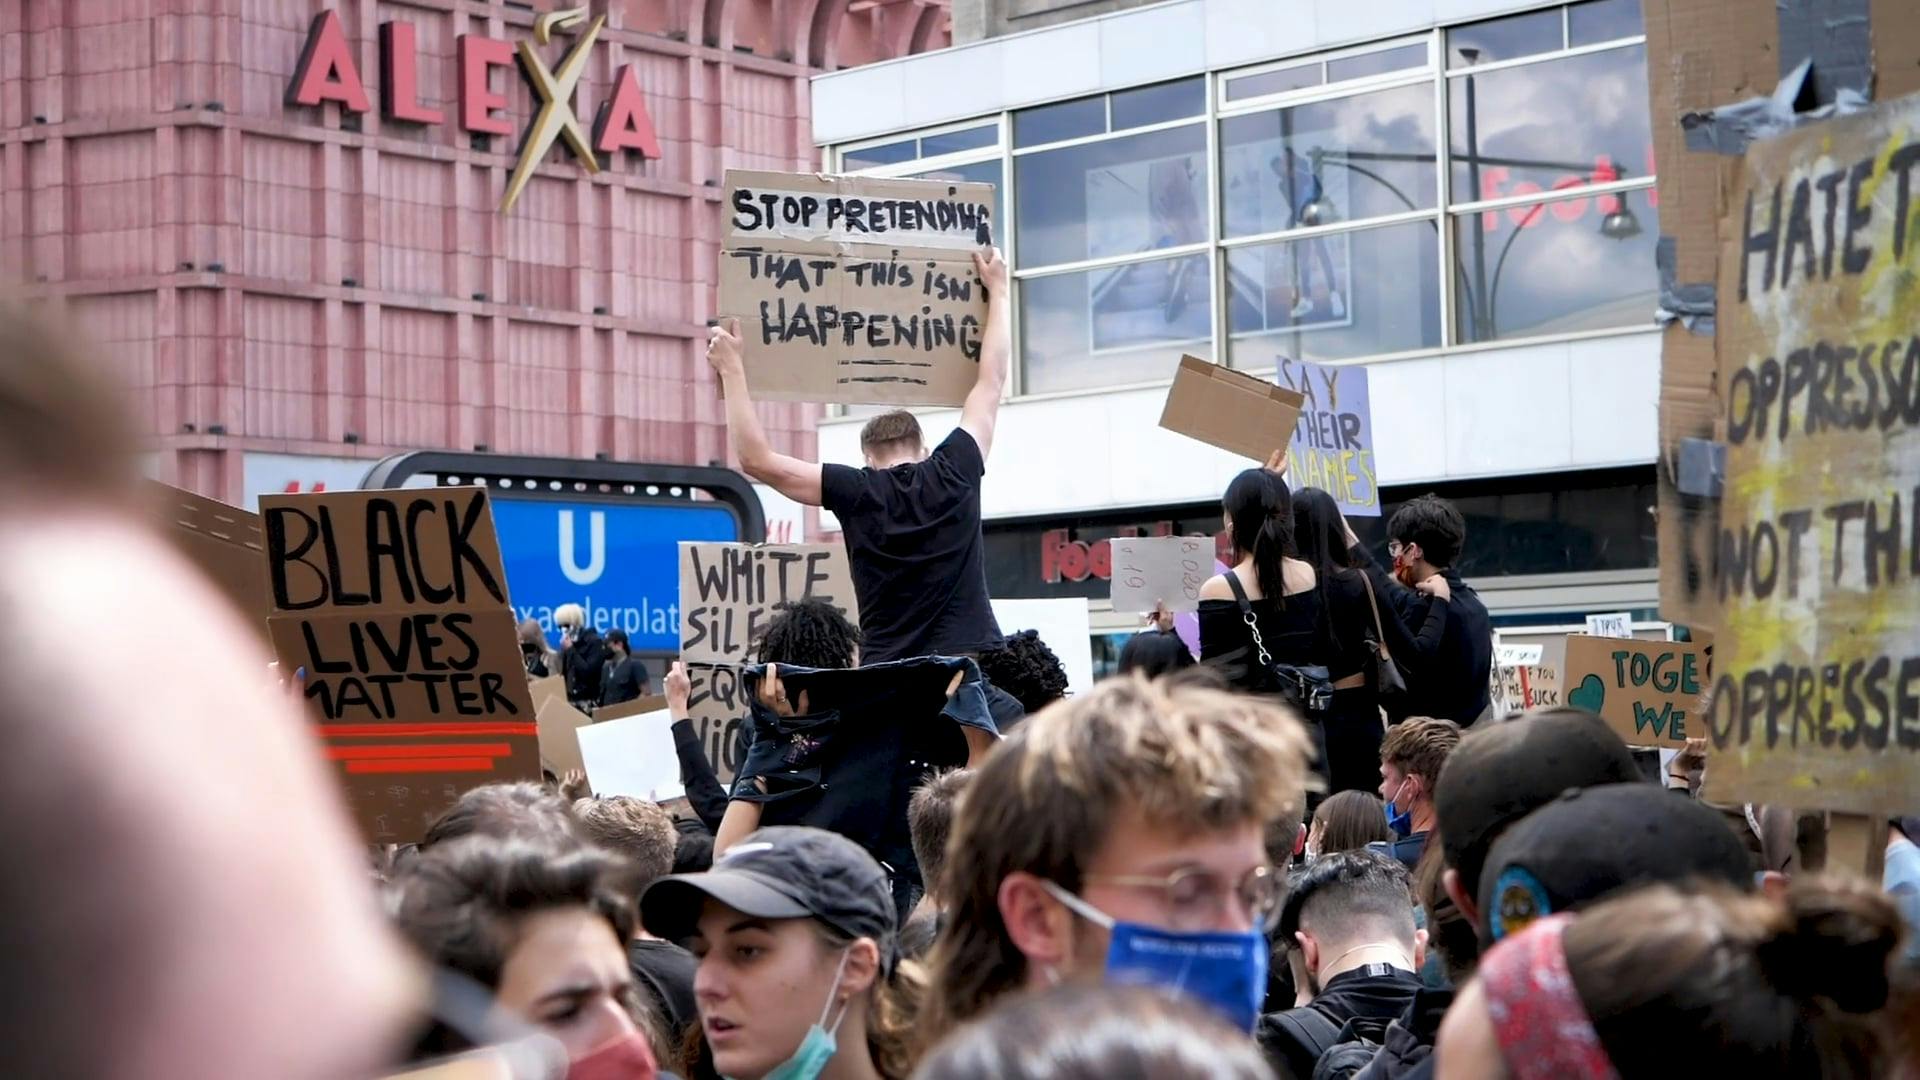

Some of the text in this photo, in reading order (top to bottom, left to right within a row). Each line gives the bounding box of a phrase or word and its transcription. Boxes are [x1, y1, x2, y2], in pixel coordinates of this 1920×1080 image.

[294, 7, 662, 213] ALEXA
[732, 189, 818, 231] STOP
[1738, 157, 1873, 303] HATE
[731, 247, 836, 293] THAT
[1282, 358, 1338, 411] SAY
[1296, 411, 1362, 450] THEIR
[1288, 448, 1377, 507] NAMES
[265, 491, 505, 610] BLACK
[558, 510, 606, 585] U
[1041, 525, 1138, 583] Foo
[1717, 508, 1812, 603] NOT
[301, 614, 479, 674] LIVES
[519, 595, 679, 635] xaderplat
[1633, 700, 1687, 742] WE
